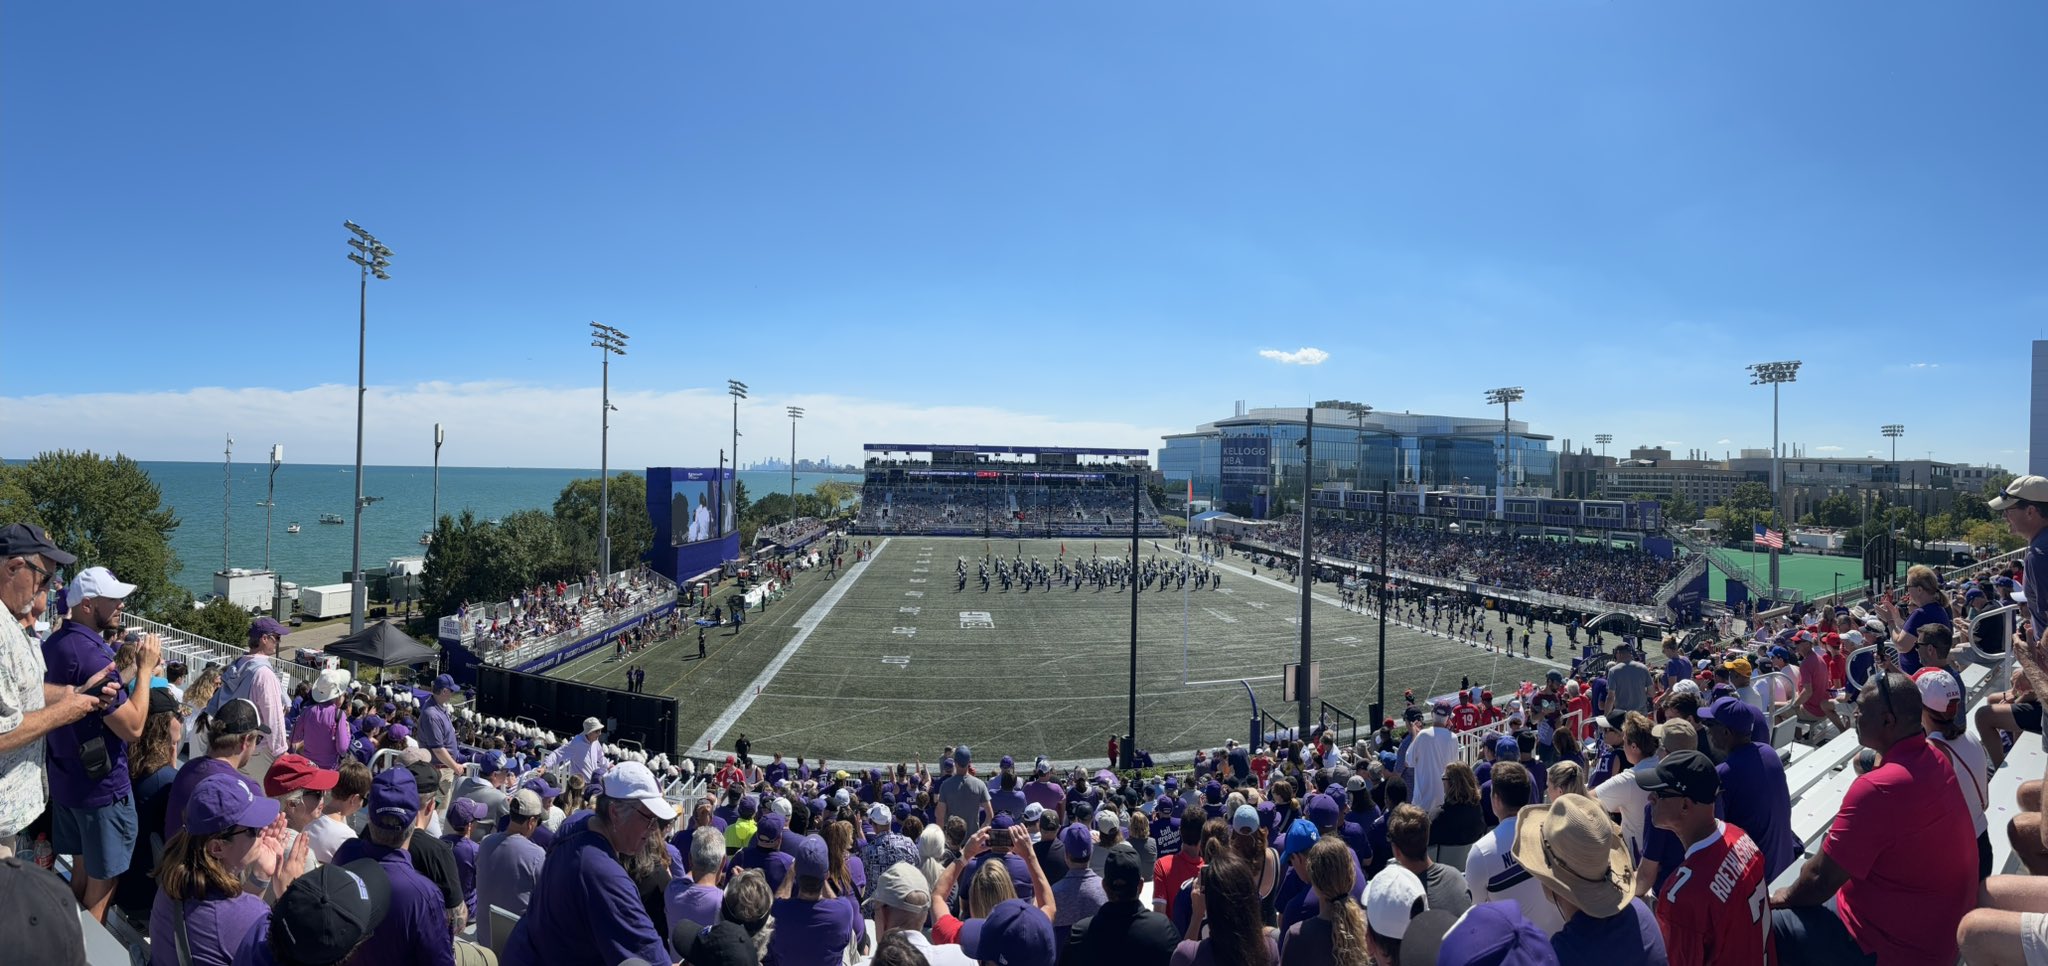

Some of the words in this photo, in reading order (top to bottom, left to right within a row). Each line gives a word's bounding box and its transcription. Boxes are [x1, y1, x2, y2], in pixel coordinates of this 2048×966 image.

[1223, 447, 1266, 456] KELLOGG
[1223, 456, 1244, 465] MBA:
[443, 620, 455, 628] EAST
[441, 626, 459, 636] STANDS
[1462, 713, 1474, 727] 19
[1160, 825, 1171, 837] tail
[1157, 829, 1180, 846] greater
[1667, 866, 1692, 903] 7
